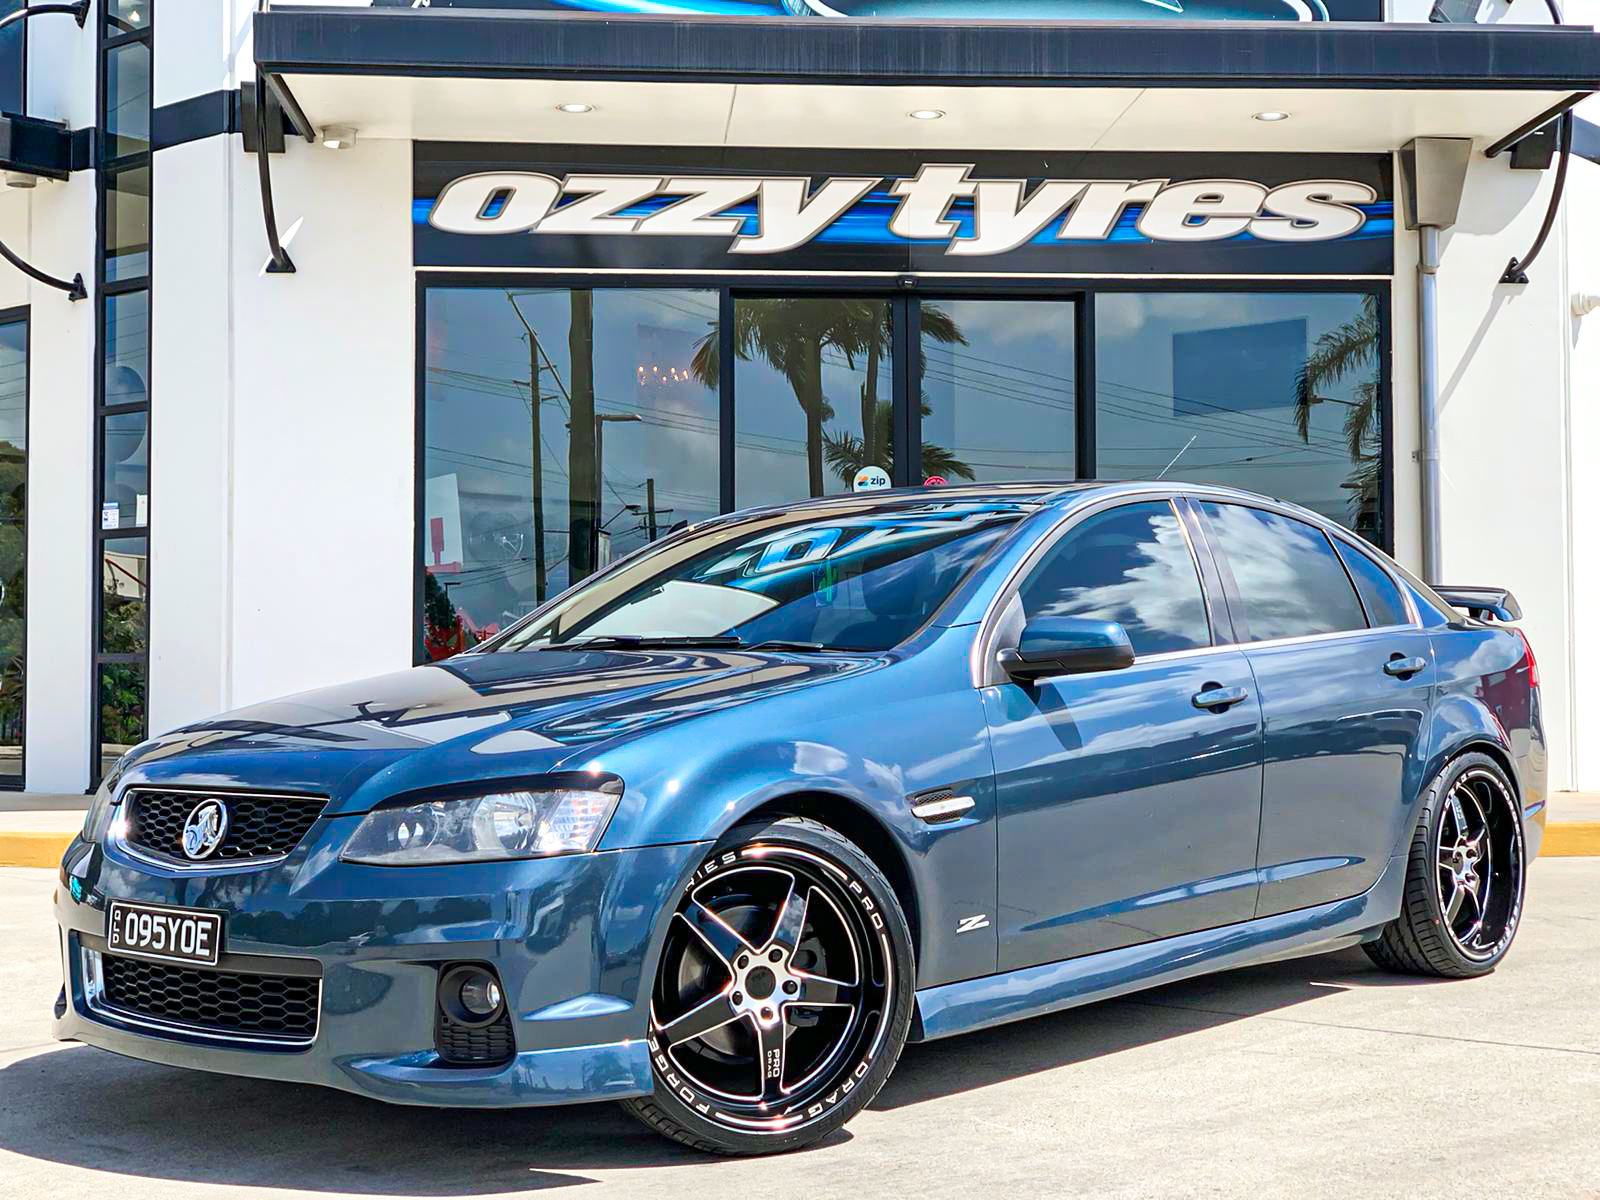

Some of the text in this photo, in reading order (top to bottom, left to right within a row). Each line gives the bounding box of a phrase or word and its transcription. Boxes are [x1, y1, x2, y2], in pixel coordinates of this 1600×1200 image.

[428, 163, 1377, 255] ozzy tyres
[870, 475, 886, 487] zip
[112, 909, 121, 944] QLD
[848, 880, 884, 930] PRO
[124, 911, 213, 957] 095YOE
[772, 1048, 780, 1078] PRO
[807, 1061, 869, 1118] DRAG
